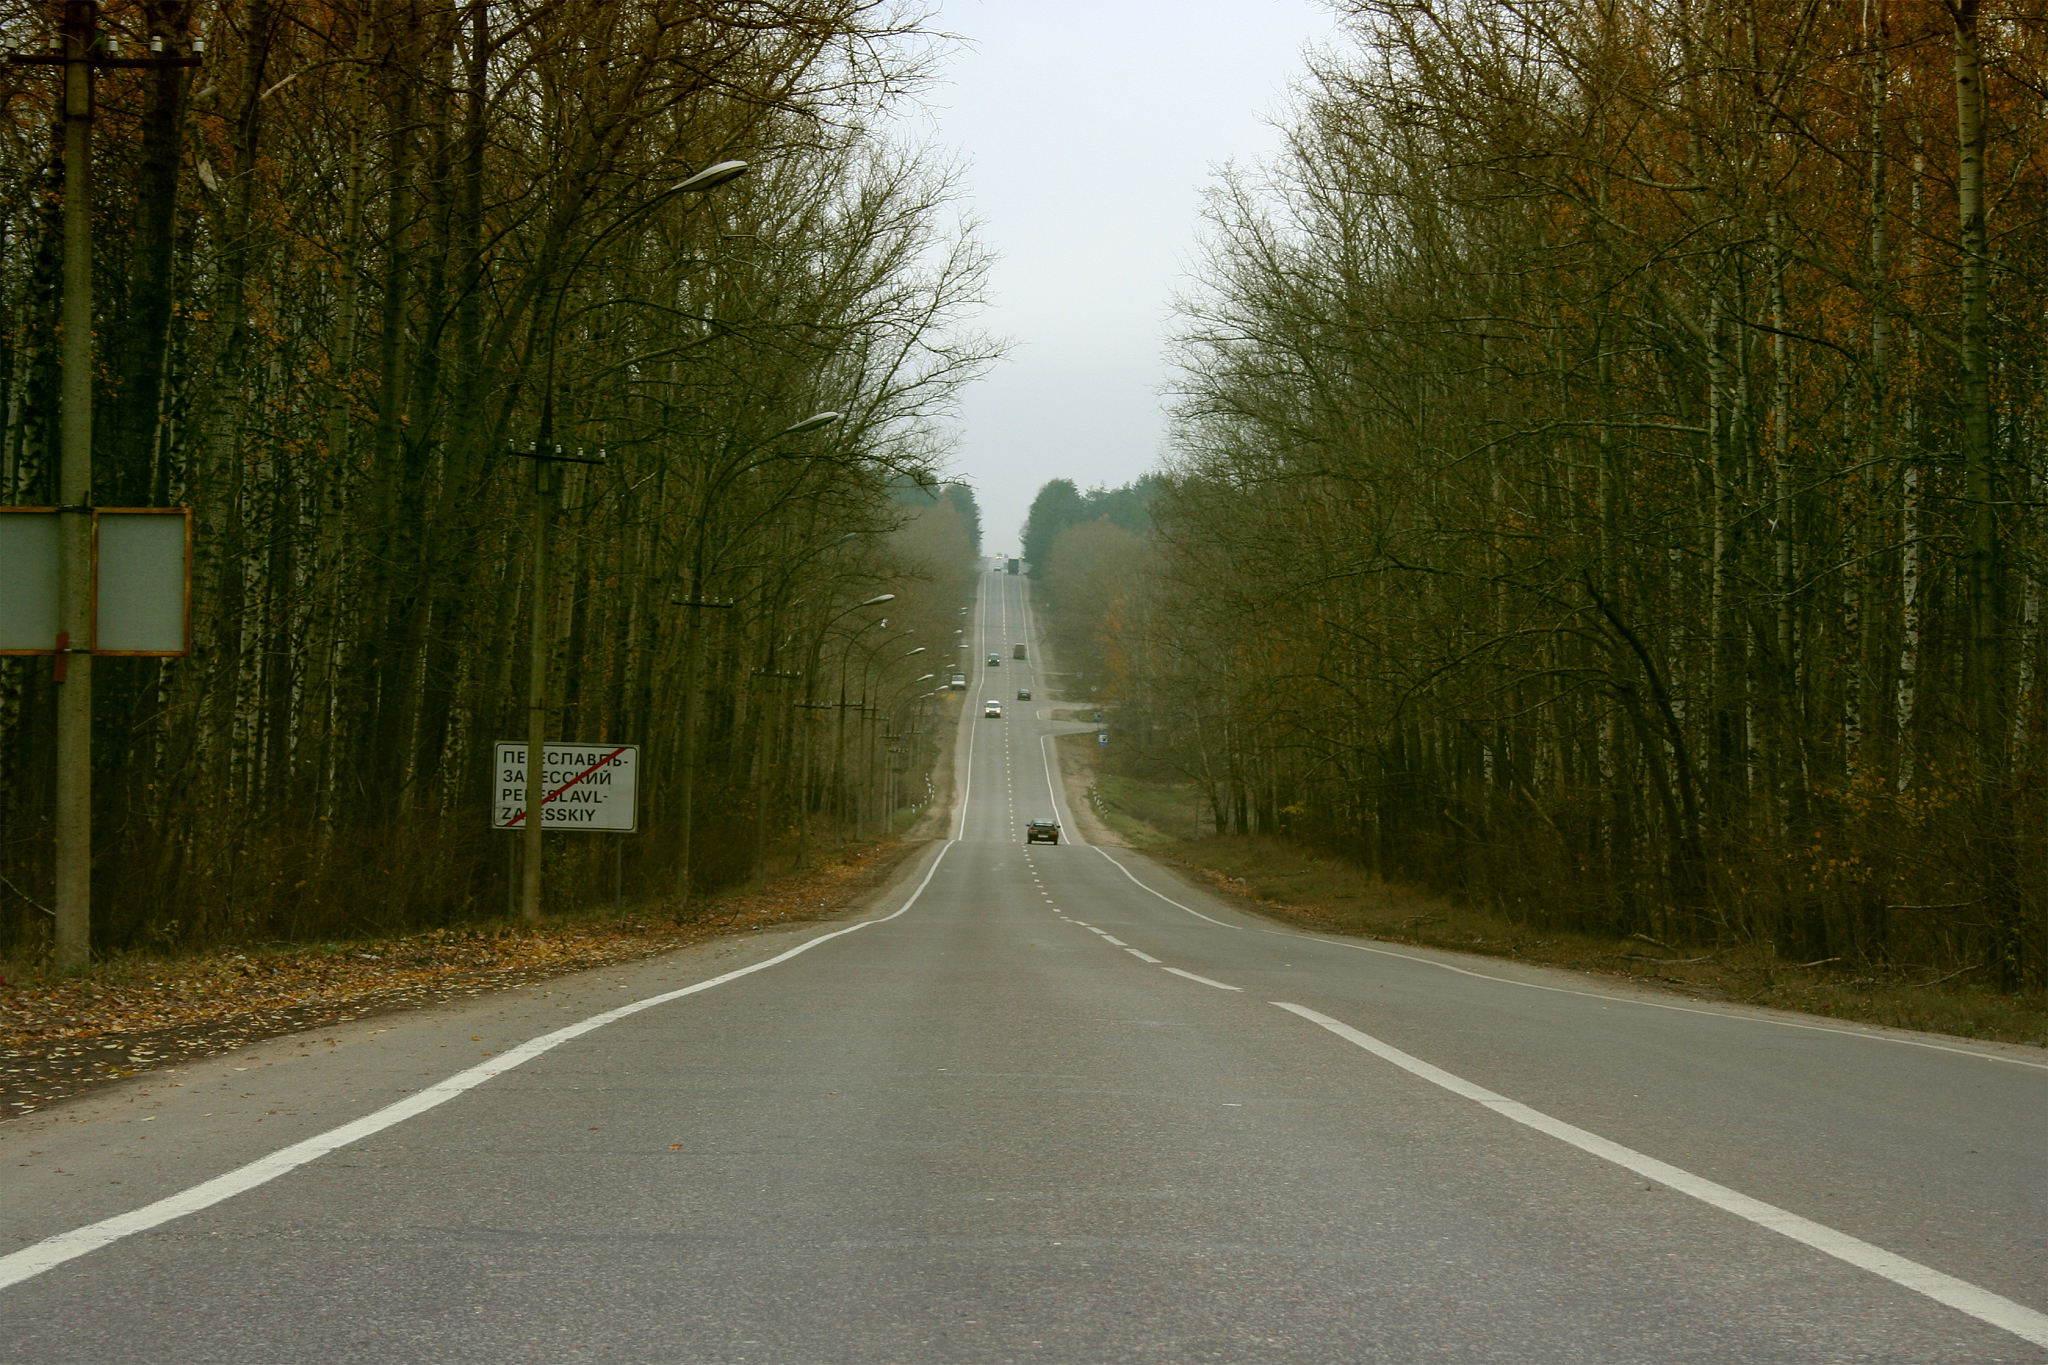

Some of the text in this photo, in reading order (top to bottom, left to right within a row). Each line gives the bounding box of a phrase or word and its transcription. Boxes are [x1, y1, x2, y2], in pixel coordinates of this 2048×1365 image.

[503, 751, 629, 767] ПЕСЛАВЛЬ-
[502, 769, 611, 785] ЗАЕССКИЙ
[502, 788, 608, 803] PESLAVL-
[501, 807, 596, 822] ZASSKIY
